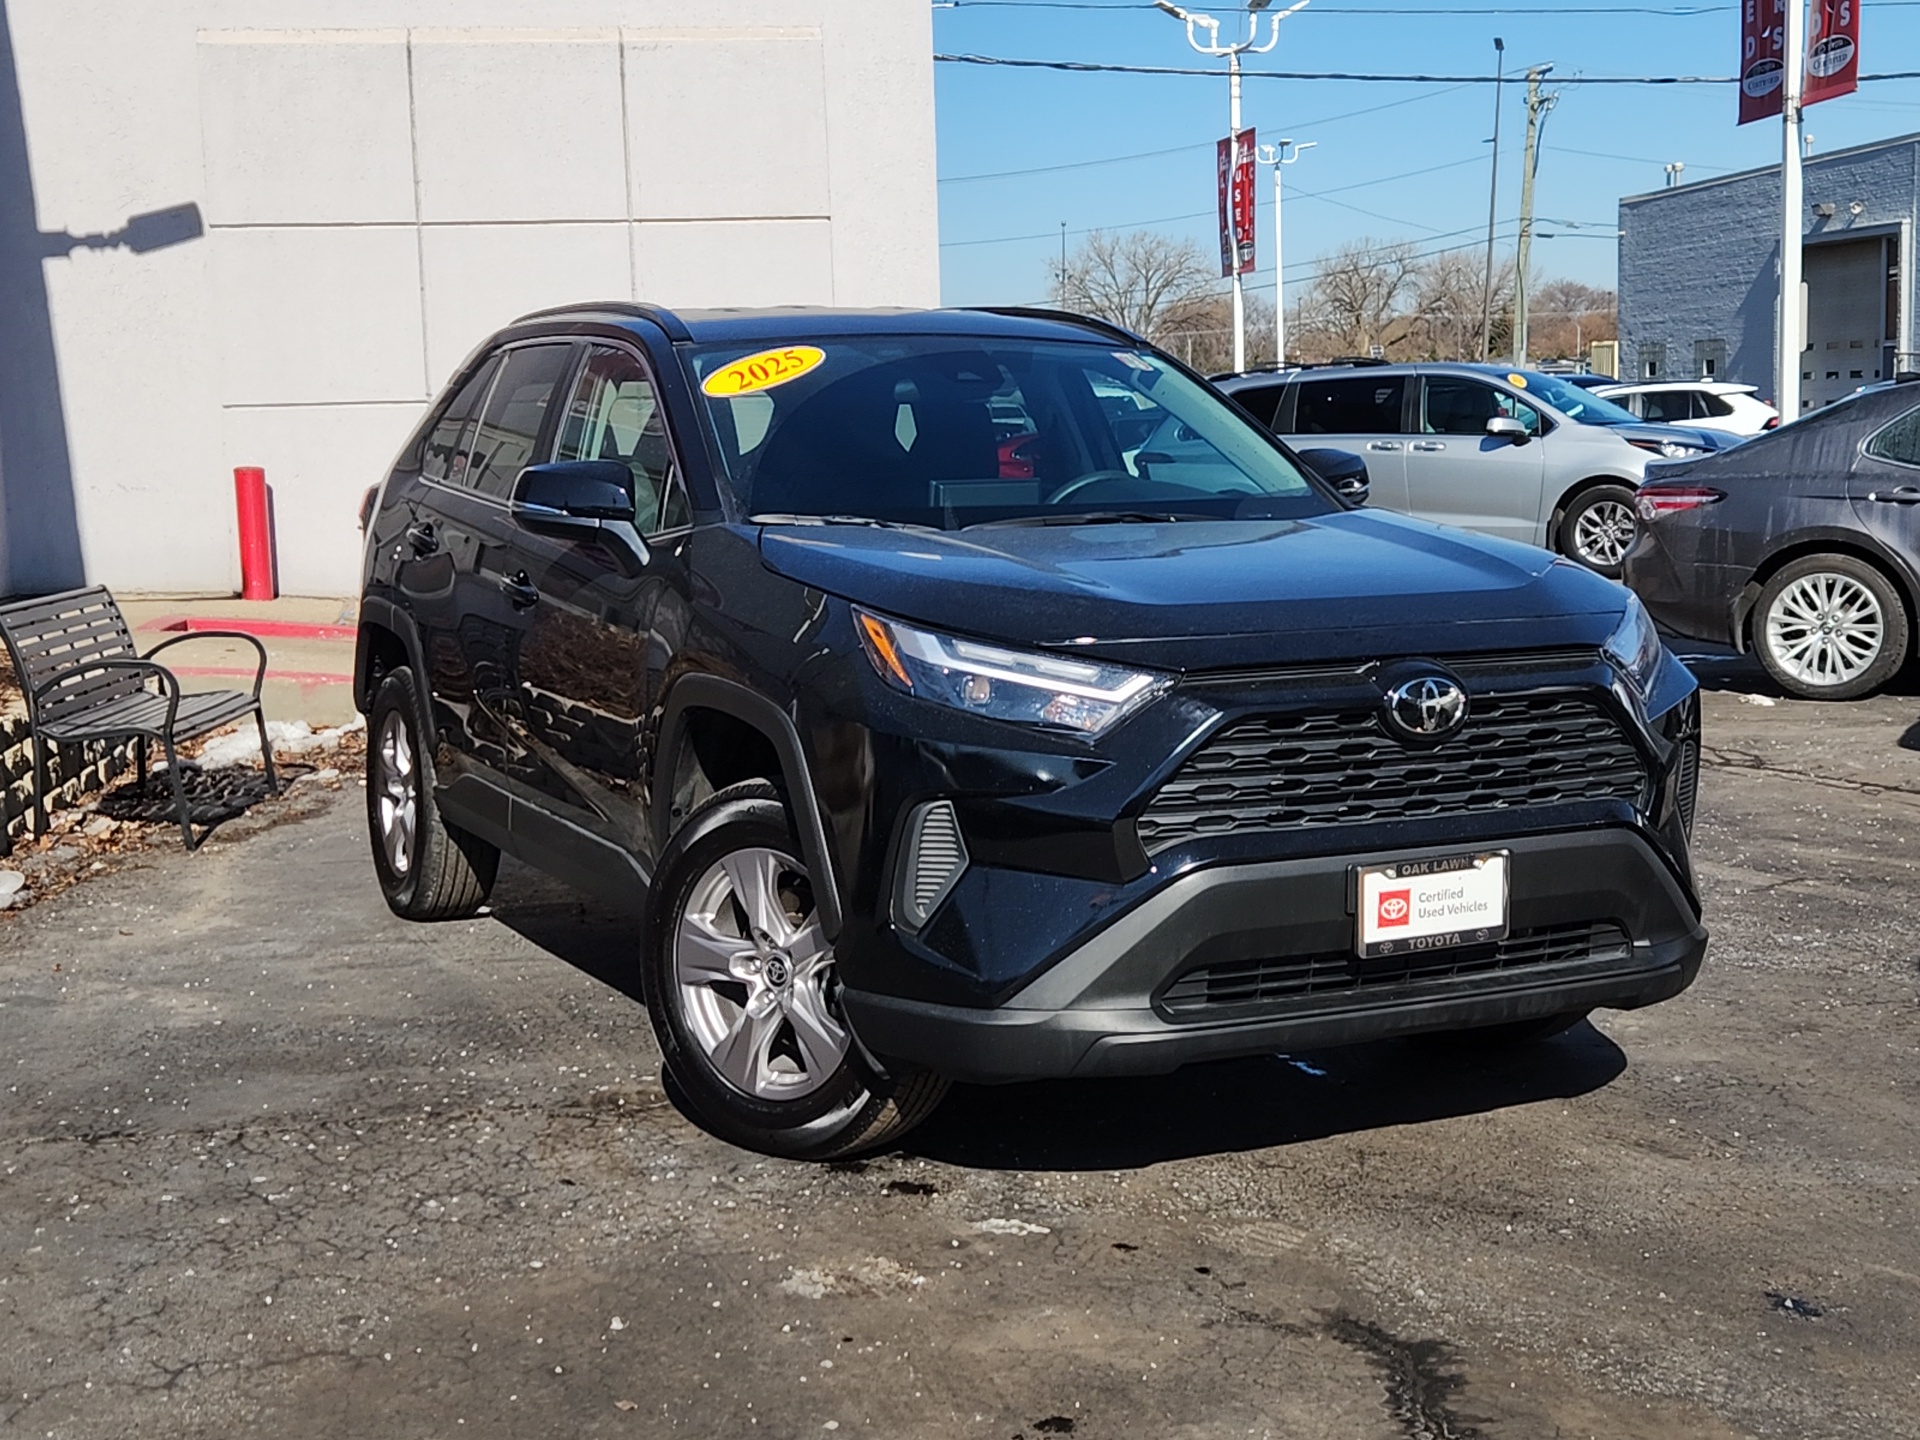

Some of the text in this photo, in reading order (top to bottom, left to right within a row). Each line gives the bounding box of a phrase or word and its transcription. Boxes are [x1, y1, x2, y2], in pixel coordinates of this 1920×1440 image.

[728, 350, 804, 391] 2025
[1401, 857, 1470, 876] OAK LAWN
[1418, 887, 1464, 903] Certified
[1418, 901, 1488, 918] Used Vehicles
[1408, 933, 1461, 950] TOYOTA
